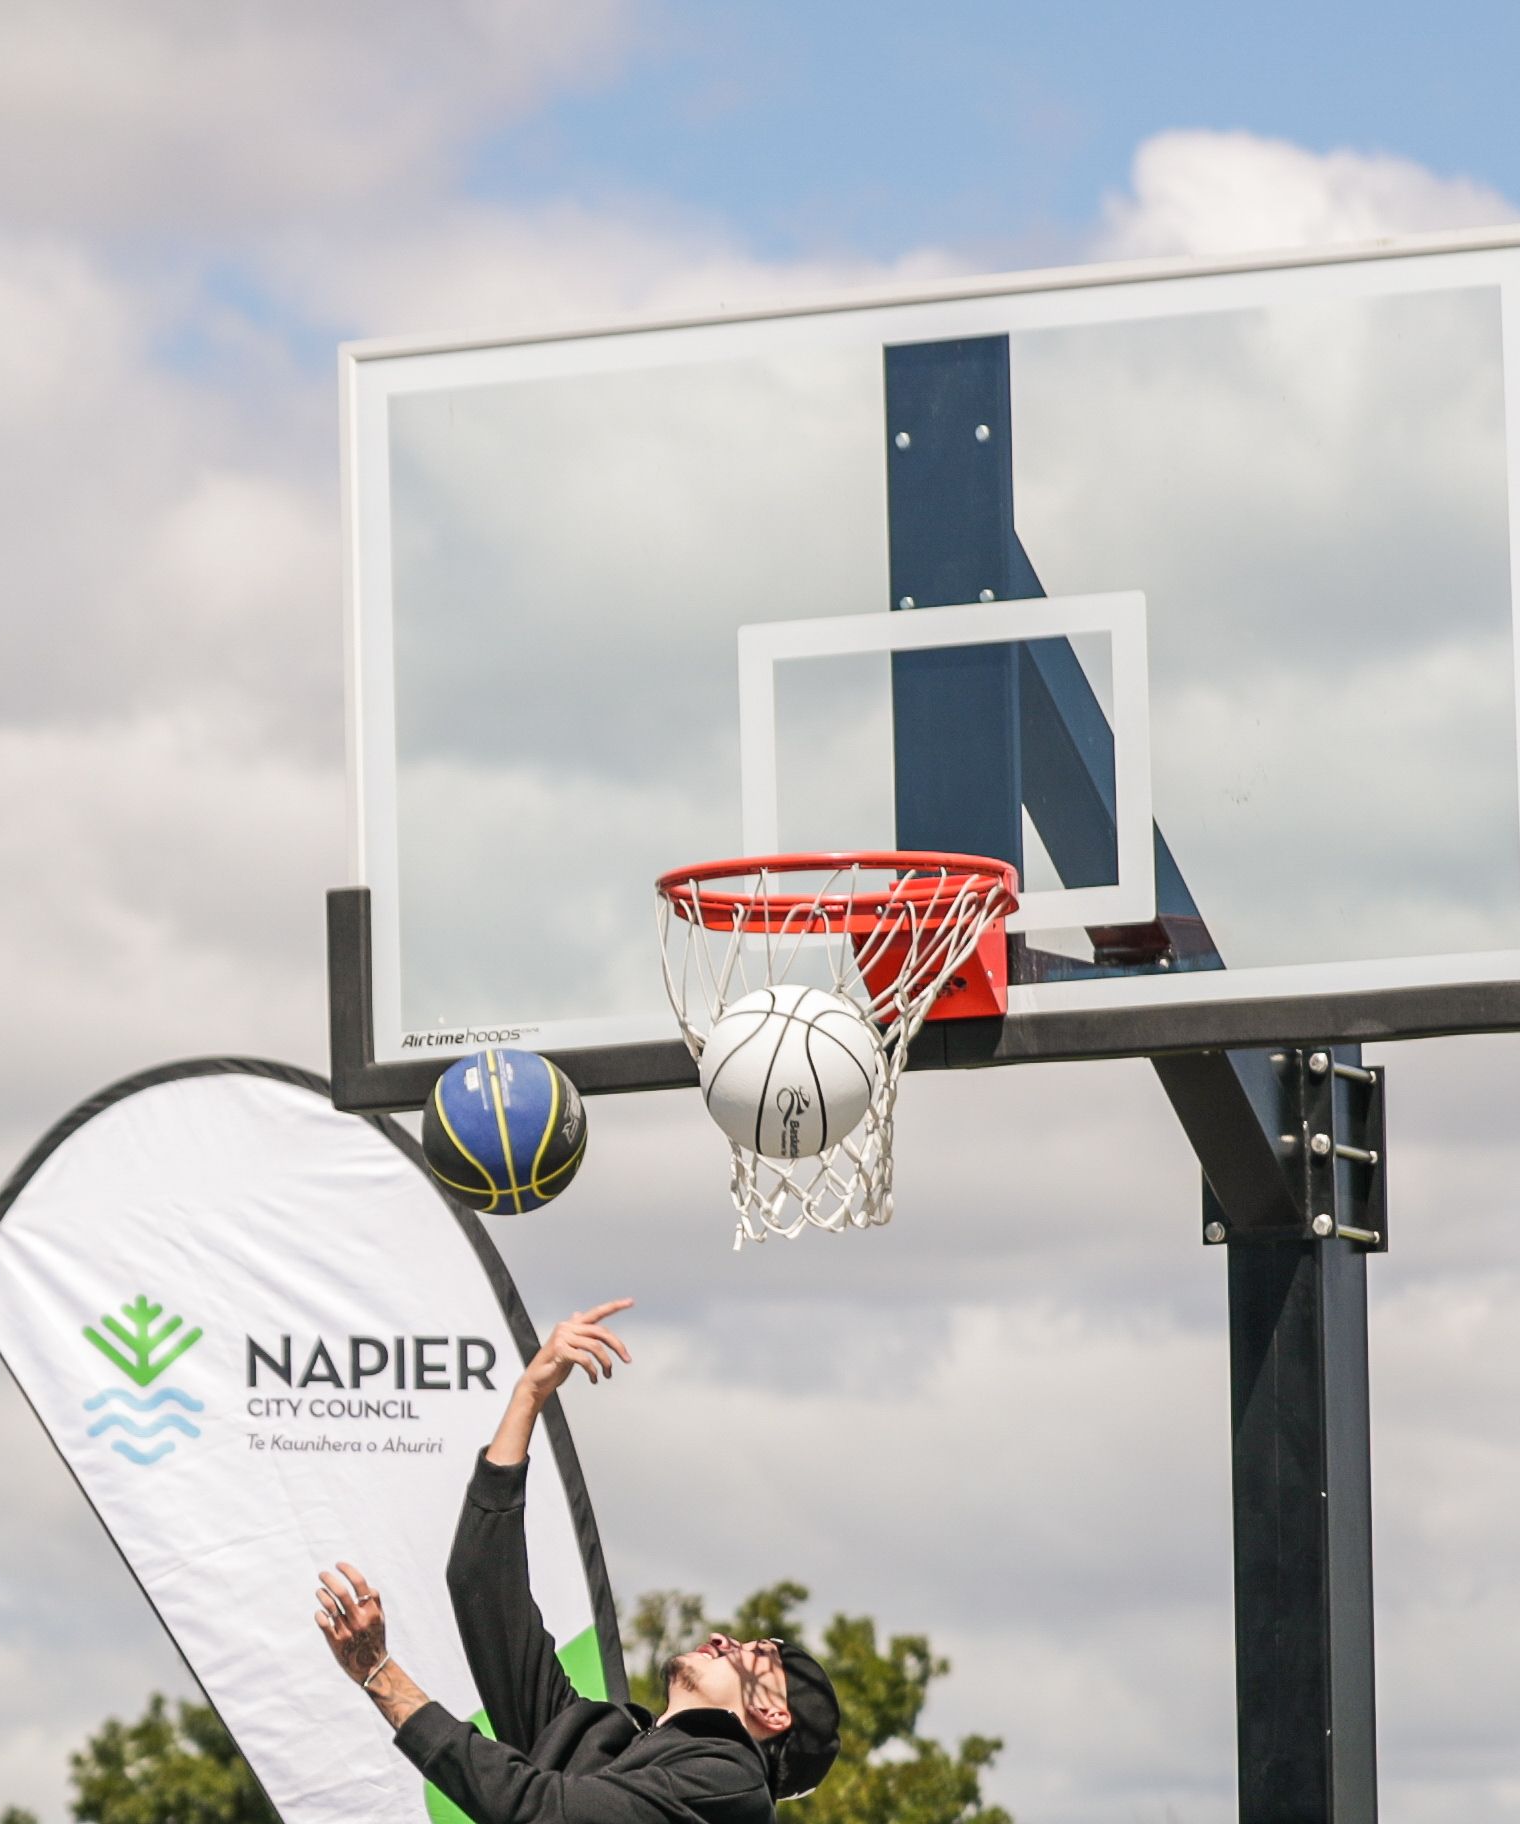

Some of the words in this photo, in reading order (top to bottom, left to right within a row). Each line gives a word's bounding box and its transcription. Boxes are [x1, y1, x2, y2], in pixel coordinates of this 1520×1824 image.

[245, 1333, 497, 1390] NAPIER
[246, 1397, 303, 1419] CITY
[308, 1399, 420, 1420] COUNCIL
[247, 1433, 266, 1451] Te
[270, 1434, 362, 1453] Kaunihera
[365, 1440, 378, 1453] o
[382, 1437, 445, 1454] Ahuriri
